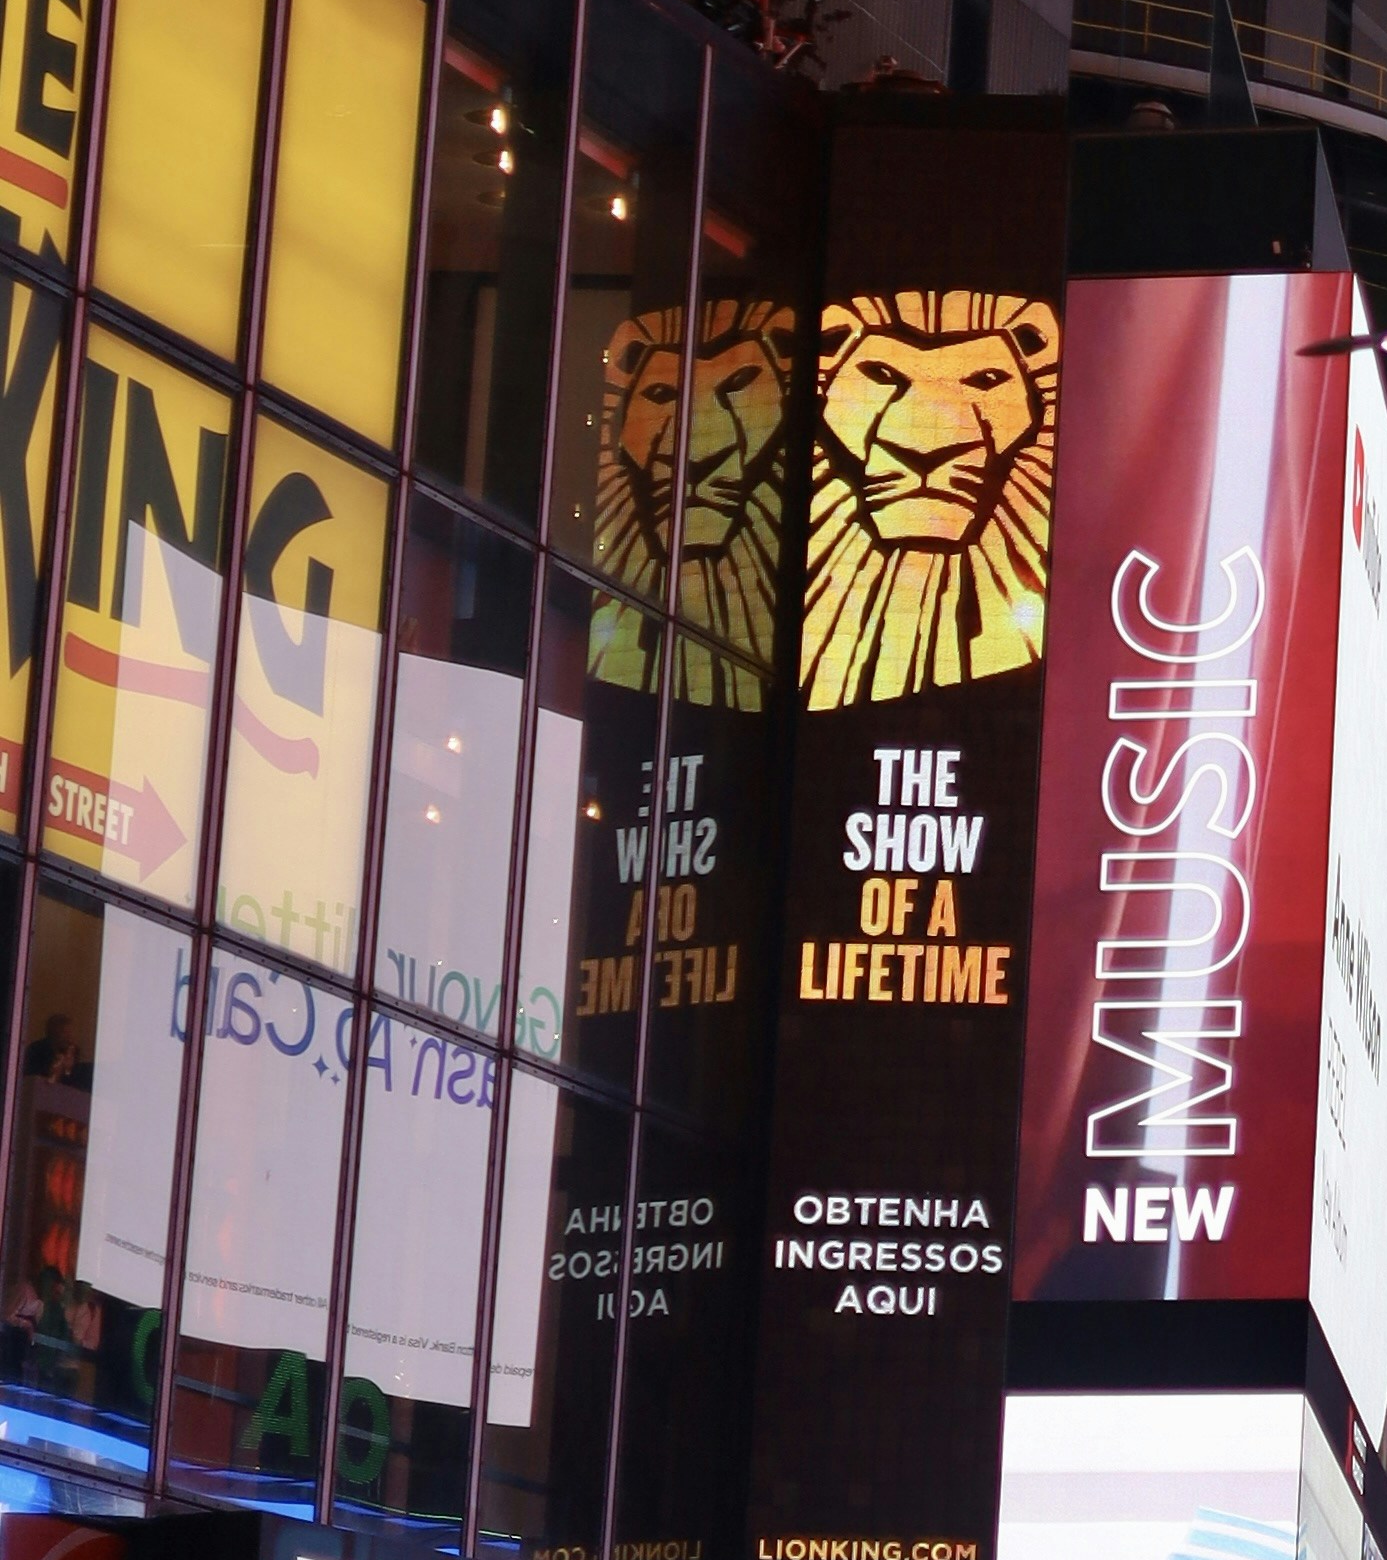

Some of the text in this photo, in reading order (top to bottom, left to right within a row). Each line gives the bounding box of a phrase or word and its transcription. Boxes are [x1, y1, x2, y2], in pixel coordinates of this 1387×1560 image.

[872, 748, 962, 808] THE
[48, 773, 134, 846] STREET
[842, 811, 984, 874] SHOW
[1085, 544, 1266, 1158] MUSIC
[859, 878, 957, 938] OF A
[799, 941, 1012, 1005] LIFETIME
[793, 1194, 990, 1230] OBTENHA
[1082, 1185, 1235, 1243] NEW
[774, 1239, 1004, 1275] INGRESSOS
[834, 1284, 937, 1318] AQUI
